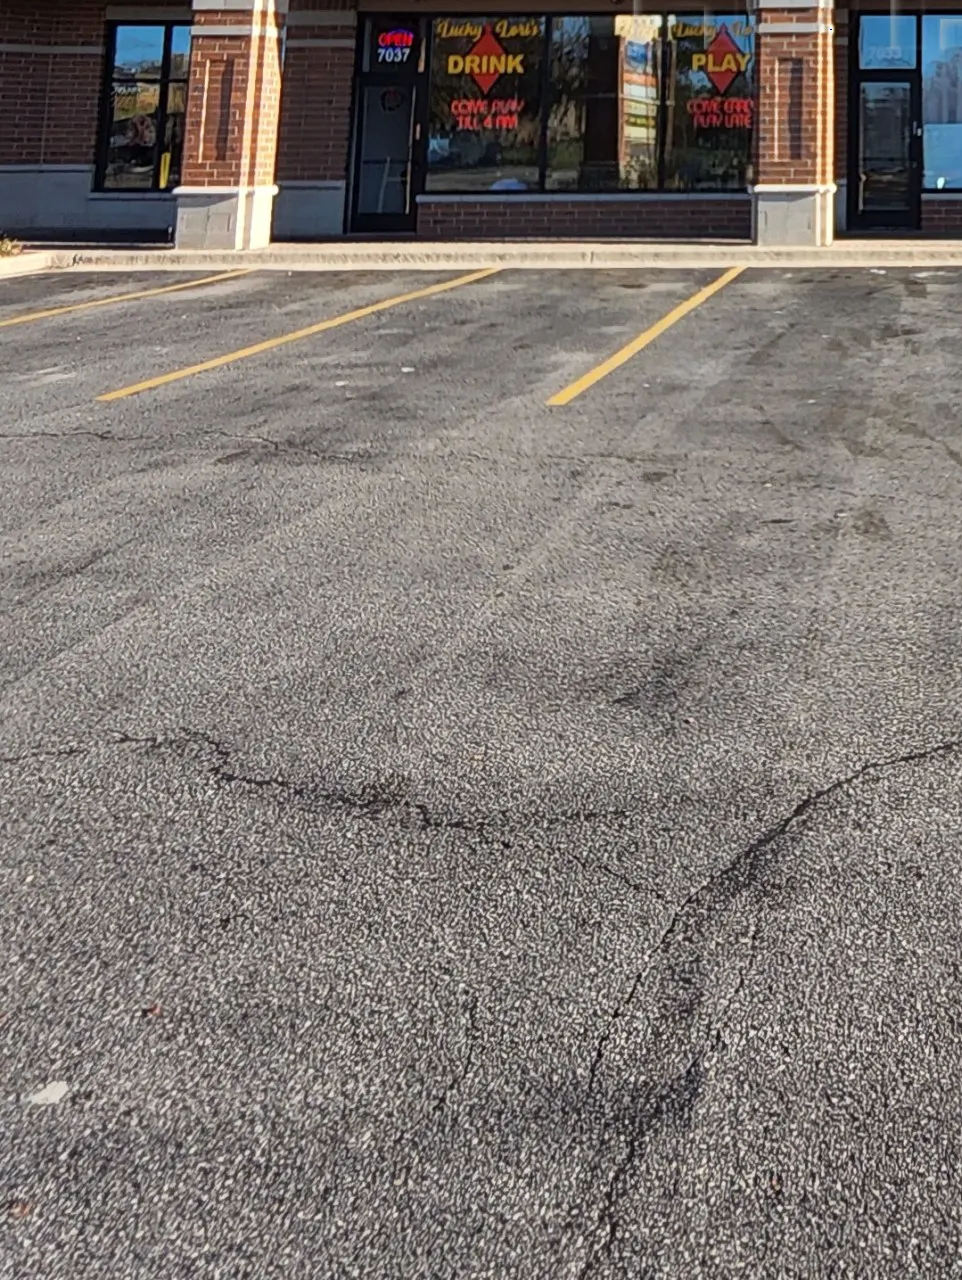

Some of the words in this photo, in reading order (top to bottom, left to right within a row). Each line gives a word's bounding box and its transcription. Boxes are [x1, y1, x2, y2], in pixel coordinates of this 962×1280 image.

[378, 31, 413, 47] OPEN
[437, 22, 484, 42] Lucky
[377, 47, 410, 63] 7037
[691, 53, 751, 72] PLAY
[447, 54, 524, 74] DRINK
[451, 100, 489, 116] COME
